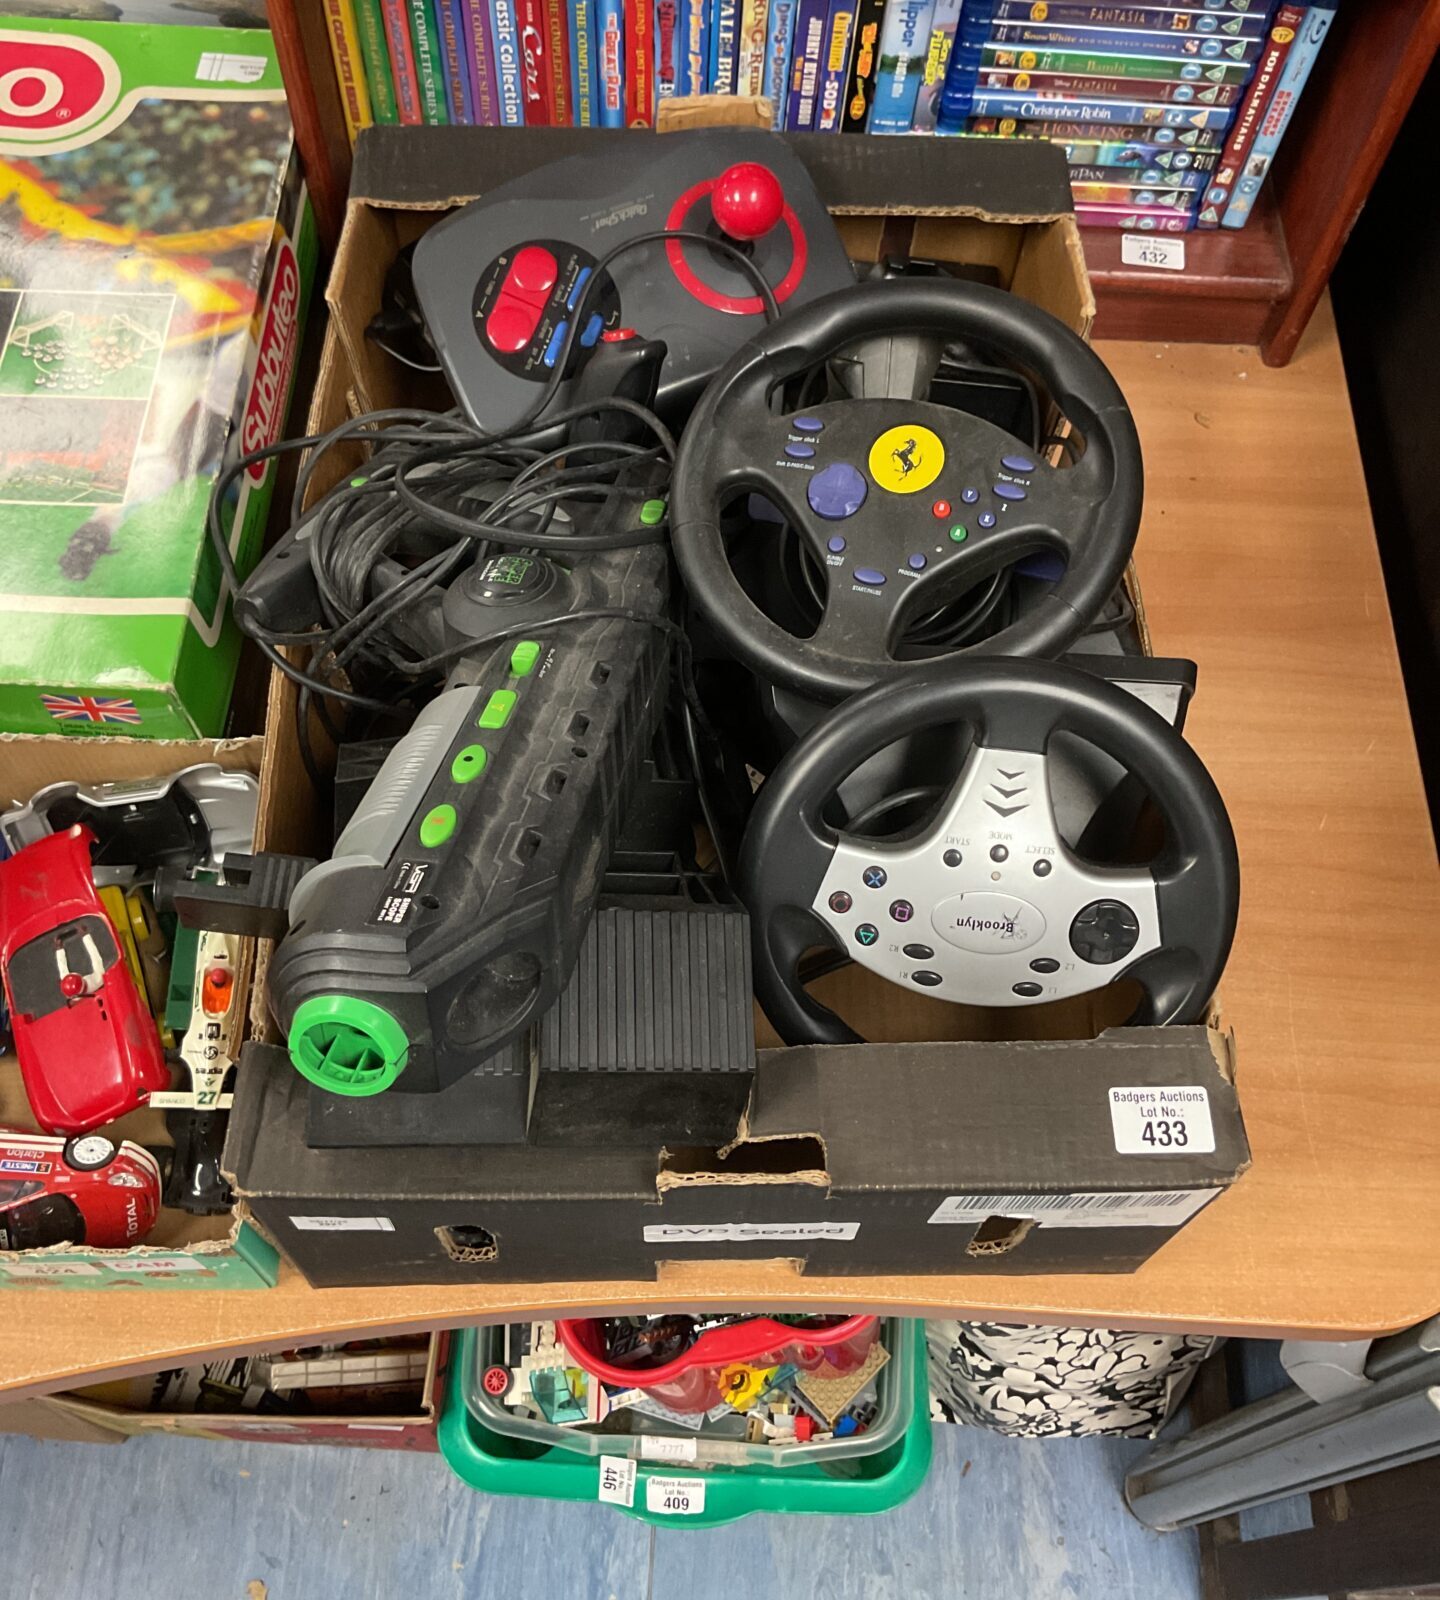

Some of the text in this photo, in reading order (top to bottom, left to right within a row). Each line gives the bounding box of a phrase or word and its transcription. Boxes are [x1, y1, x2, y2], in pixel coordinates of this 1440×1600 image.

[576, 2, 587, 28] THE
[1089, 7, 1146, 25] FANTASIA
[1022, 30, 1048, 42] Snow
[1048, 31, 1077, 44] White
[472, 14, 488, 80] COMPLETE
[550, 17, 563, 81] COMPLETE
[604, 30, 620, 72] GREAT
[414, 11, 431, 77] COMPLETE
[424, 76, 437, 116] SERIES
[522, 25, 543, 103] Cars
[577, 31, 590, 95] COMPLETE
[715, 57, 733, 95] BRA
[606, 74, 622, 110] RACE
[1072, 80, 1118, 92] FANTASIA
[478, 80, 491, 119] SERIES
[1020, 103, 1080, 119] Christopher
[1081, 105, 1112, 120] Robin
[1233, 74, 1270, 151] DALMATIANS
[1041, 123, 1086, 138] LION
[1087, 124, 1135, 140] KING
[1139, 251, 1168, 264] 432
[242, 267, 297, 464] Subbuteo
[967, 490, 973, 498] Y
[984, 514, 991, 523] X
[954, 529, 961, 537] A
[945, 835, 970, 846] START
[988, 830, 1013, 840] MODE
[1025, 845, 1056, 855] SELECT
[384, 898, 402, 922] SCOPE
[392, 897, 412, 923] SNIPER
[956, 915, 1015, 934] Brooklyn
[195, 1067, 224, 1075] saudia
[197, 1091, 217, 1105] 27
[1113, 1091, 1205, 1104] Badgers Auctions
[1140, 1107, 1158, 1118] Lot
[1142, 1120, 1188, 1147] 433
[7, 1149, 45, 1159] Clarion
[4, 1161, 30, 1170] NESTE
[125, 1197, 138, 1238] TOTAL
[662, 1227, 844, 1236] DVD Sealed
[115, 1261, 176, 1269] CAM
[602, 1467, 619, 1491] 446
[651, 1478, 703, 1488] Badgers Auctions
[664, 1488, 675, 1496] Lot
[663, 1497, 690, 1511] 409
